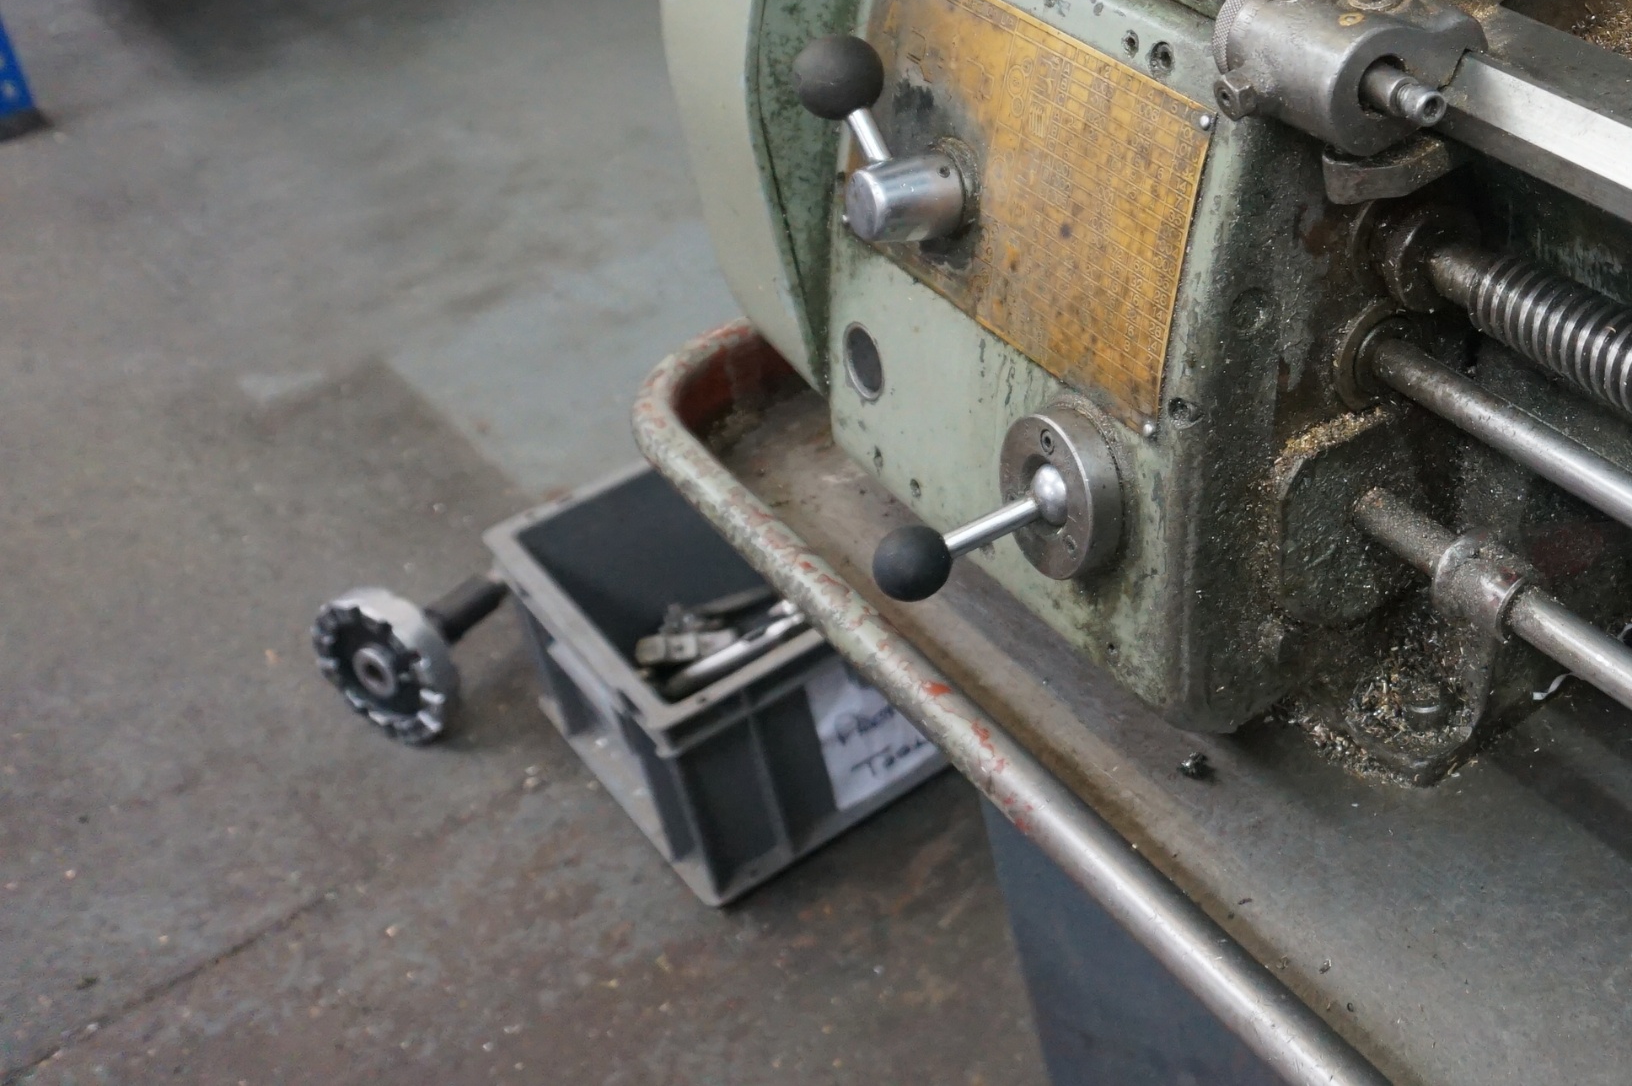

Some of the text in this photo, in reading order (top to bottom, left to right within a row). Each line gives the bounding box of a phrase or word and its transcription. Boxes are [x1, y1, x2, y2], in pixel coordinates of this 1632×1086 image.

[1103, 65, 1111, 79] 2
[1175, 178, 1187, 192] 14
[1111, 245, 1124, 261] 72
[1132, 258, 1146, 275] 64
[1130, 274, 1144, 292] 32
[1154, 289, 1167, 306] 28
[1129, 292, 1140, 307] 16
[1151, 305, 1163, 321] 14
[1123, 321, 1135, 337] 16
[1148, 321, 1162, 338] 28
[1122, 339, 1131, 353] 8
